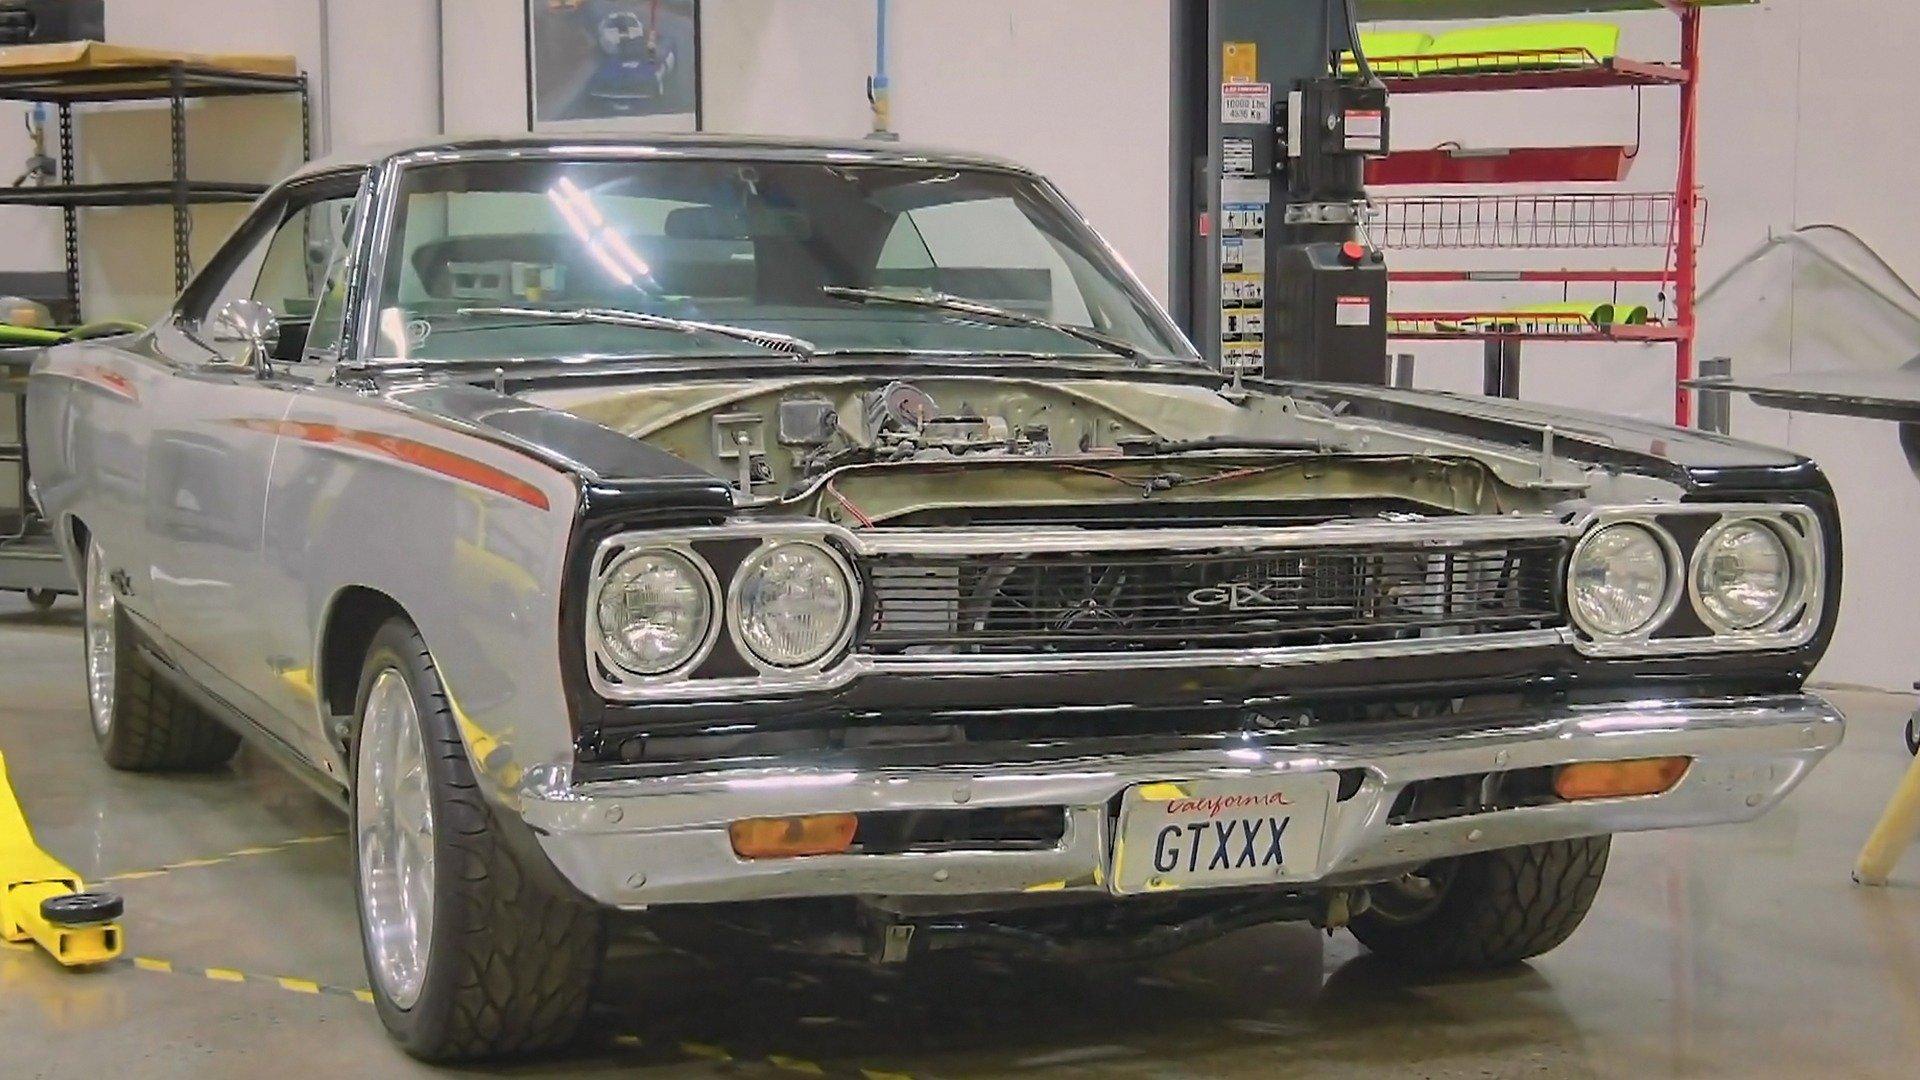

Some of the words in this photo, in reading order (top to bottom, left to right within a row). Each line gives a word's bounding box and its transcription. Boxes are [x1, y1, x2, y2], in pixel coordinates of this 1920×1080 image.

[1187, 583, 1274, 610] GTX
[1166, 791, 1292, 817] California
[1153, 816, 1291, 873] GTXXX
